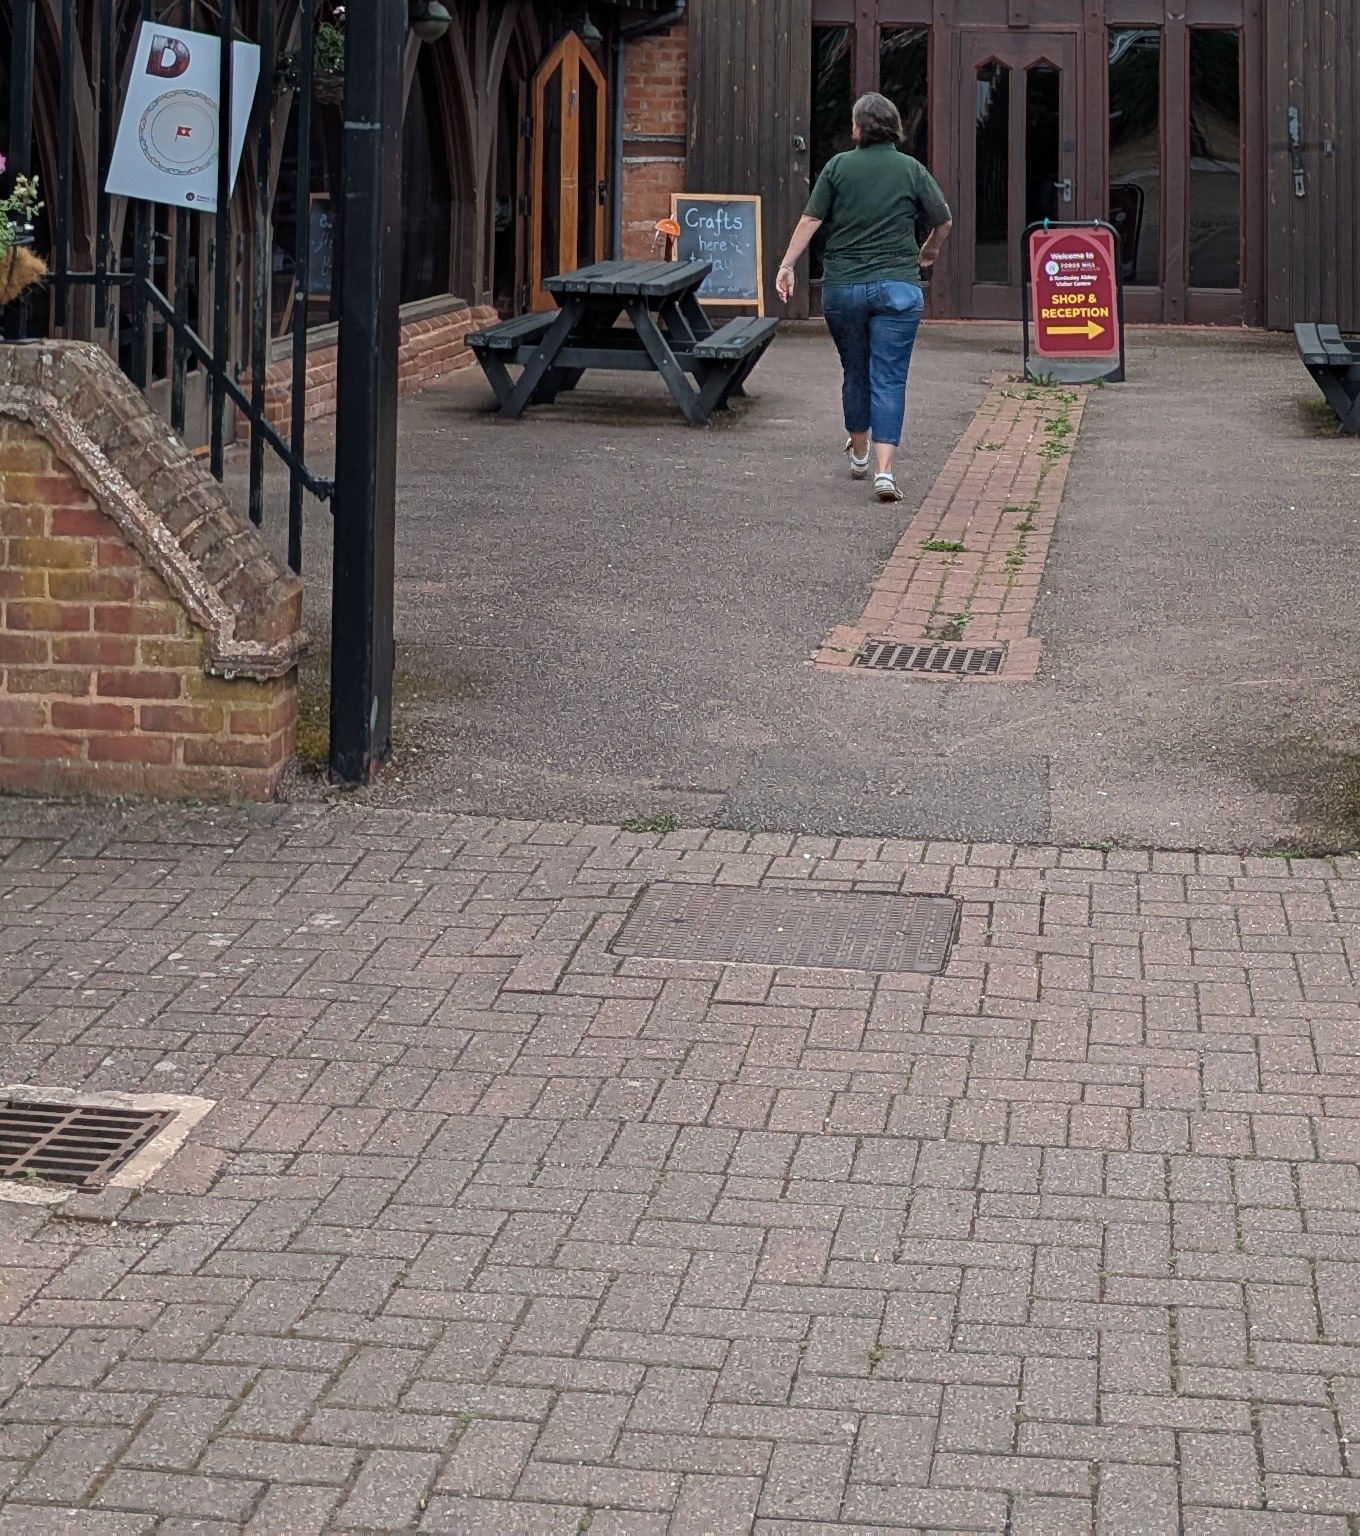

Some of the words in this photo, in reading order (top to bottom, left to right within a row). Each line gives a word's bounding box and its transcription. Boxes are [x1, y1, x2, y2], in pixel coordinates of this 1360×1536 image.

[145, 34, 191, 79] D
[685, 207, 743, 237] Crafts
[698, 234, 728, 252] here
[1050, 251, 1084, 261] Welcome
[1086, 251, 1095, 260] to
[1051, 293, 1086, 305] SHOP
[1088, 293, 1098, 304] &
[1041, 306, 1110, 319] RECEPTION
